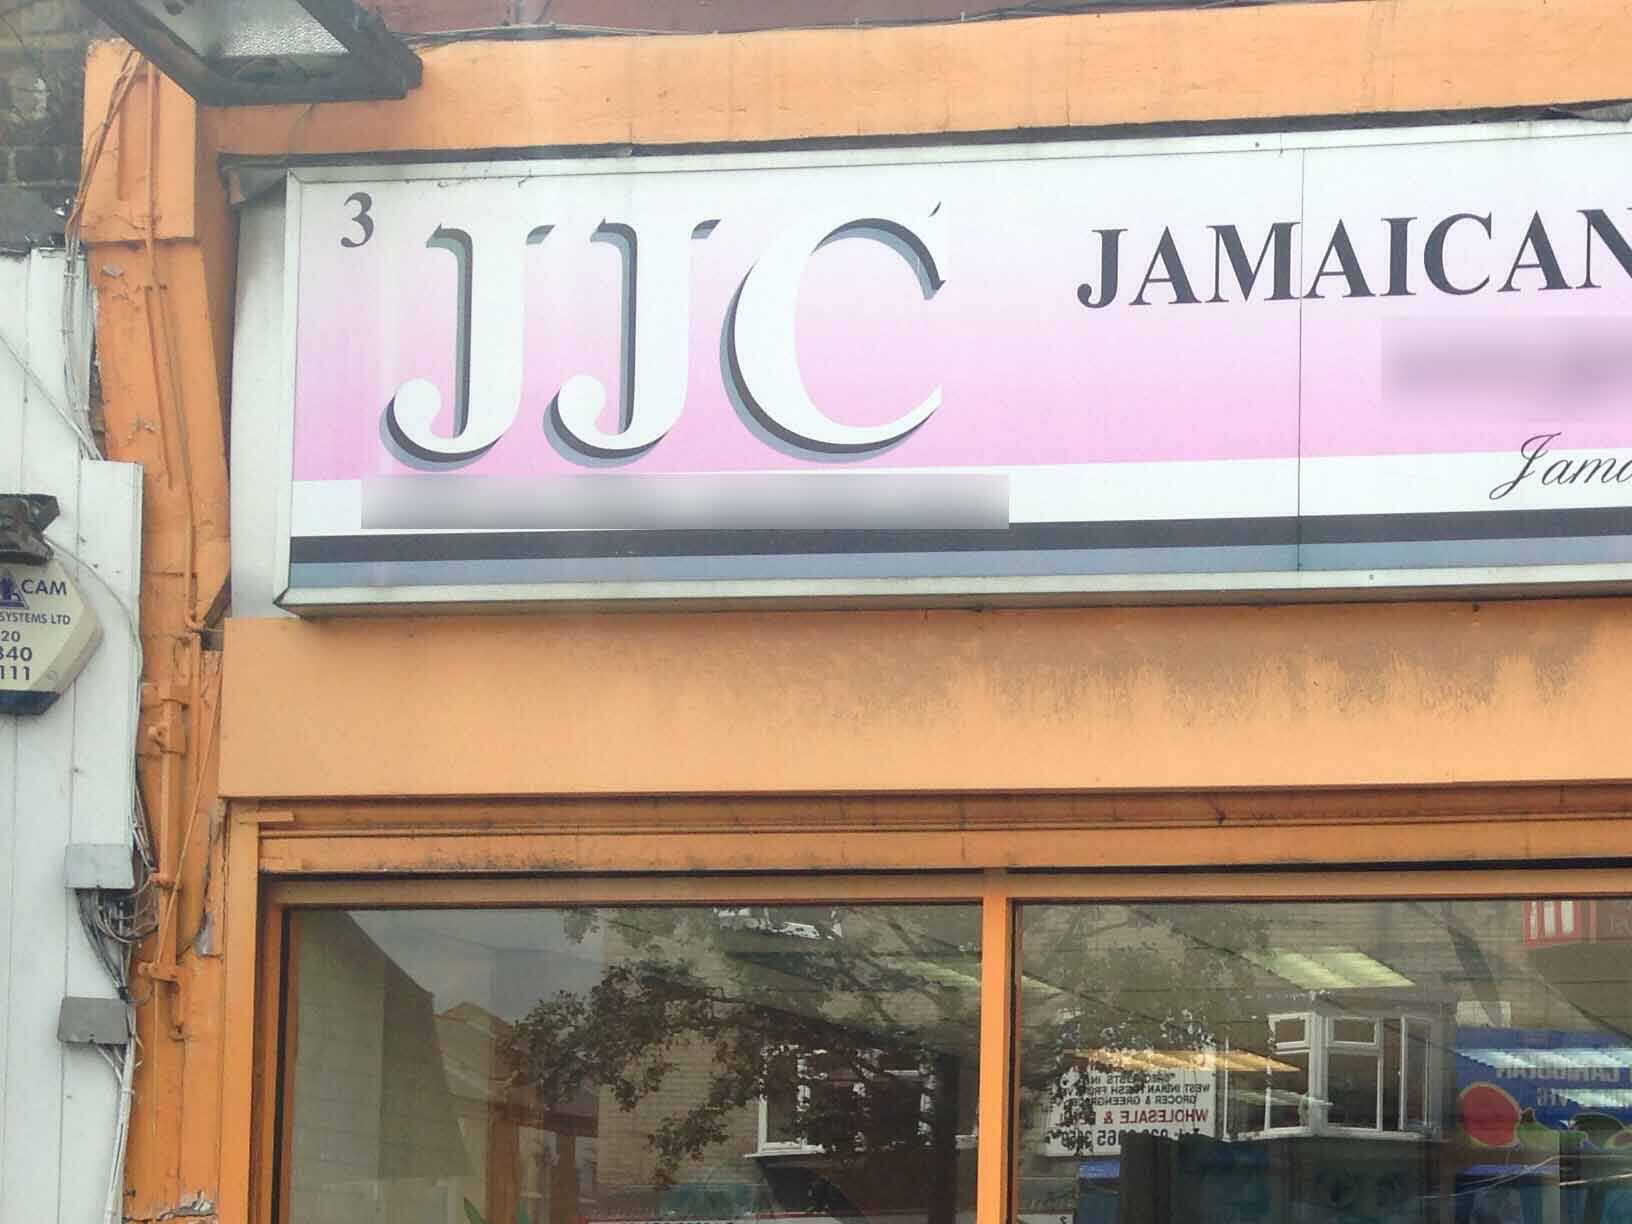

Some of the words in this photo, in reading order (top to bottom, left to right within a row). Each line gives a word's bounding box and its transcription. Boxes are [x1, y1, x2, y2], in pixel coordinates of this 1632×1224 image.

[341, 191, 374, 248] 3
[379, 200, 948, 471] JJC
[21, 578, 67, 597] CAM
[51, 613, 71, 625] LTD
